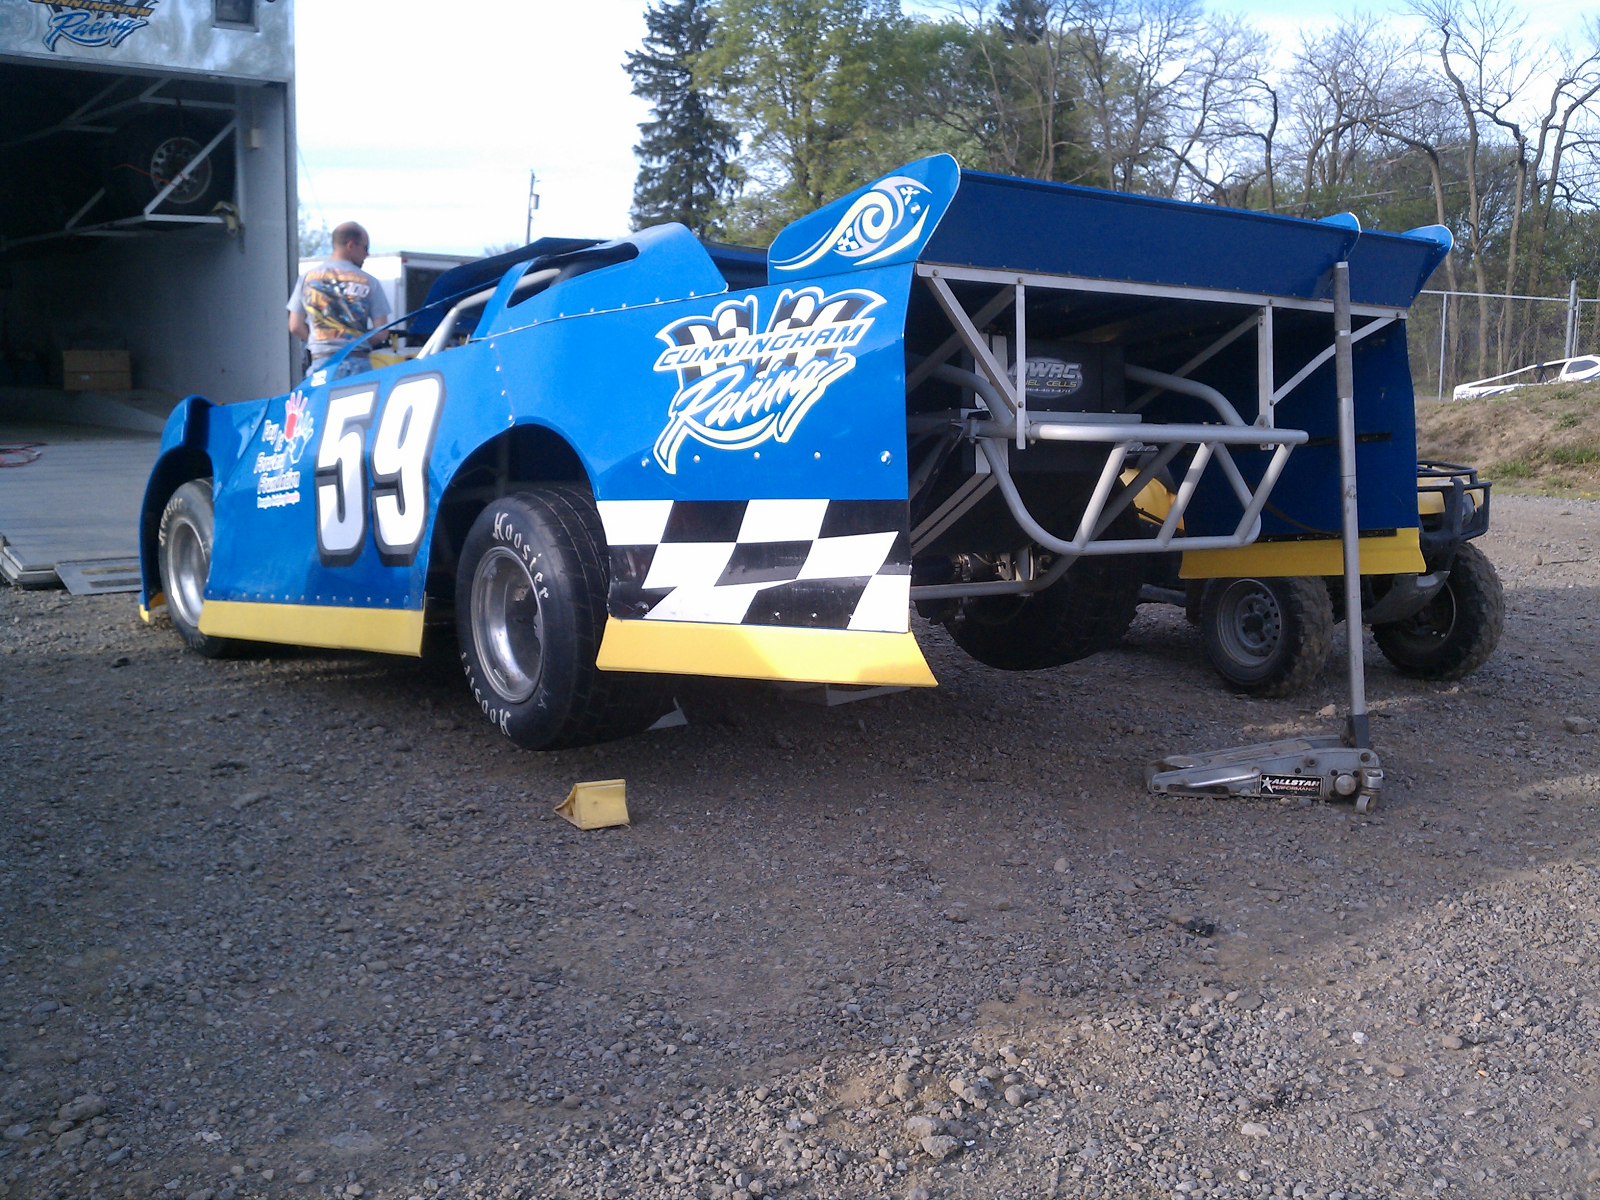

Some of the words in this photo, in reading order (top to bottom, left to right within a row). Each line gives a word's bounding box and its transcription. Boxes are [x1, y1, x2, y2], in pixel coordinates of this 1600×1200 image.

[32, 0, 152, 16] NNINGHAM
[45, 11, 146, 47] Racing
[659, 323, 863, 367] CUNNINGHAM
[1046, 380, 1078, 388] CELLS
[656, 356, 852, 468] Racing
[315, 370, 447, 567] 59
[492, 512, 549, 599] Hoosier
